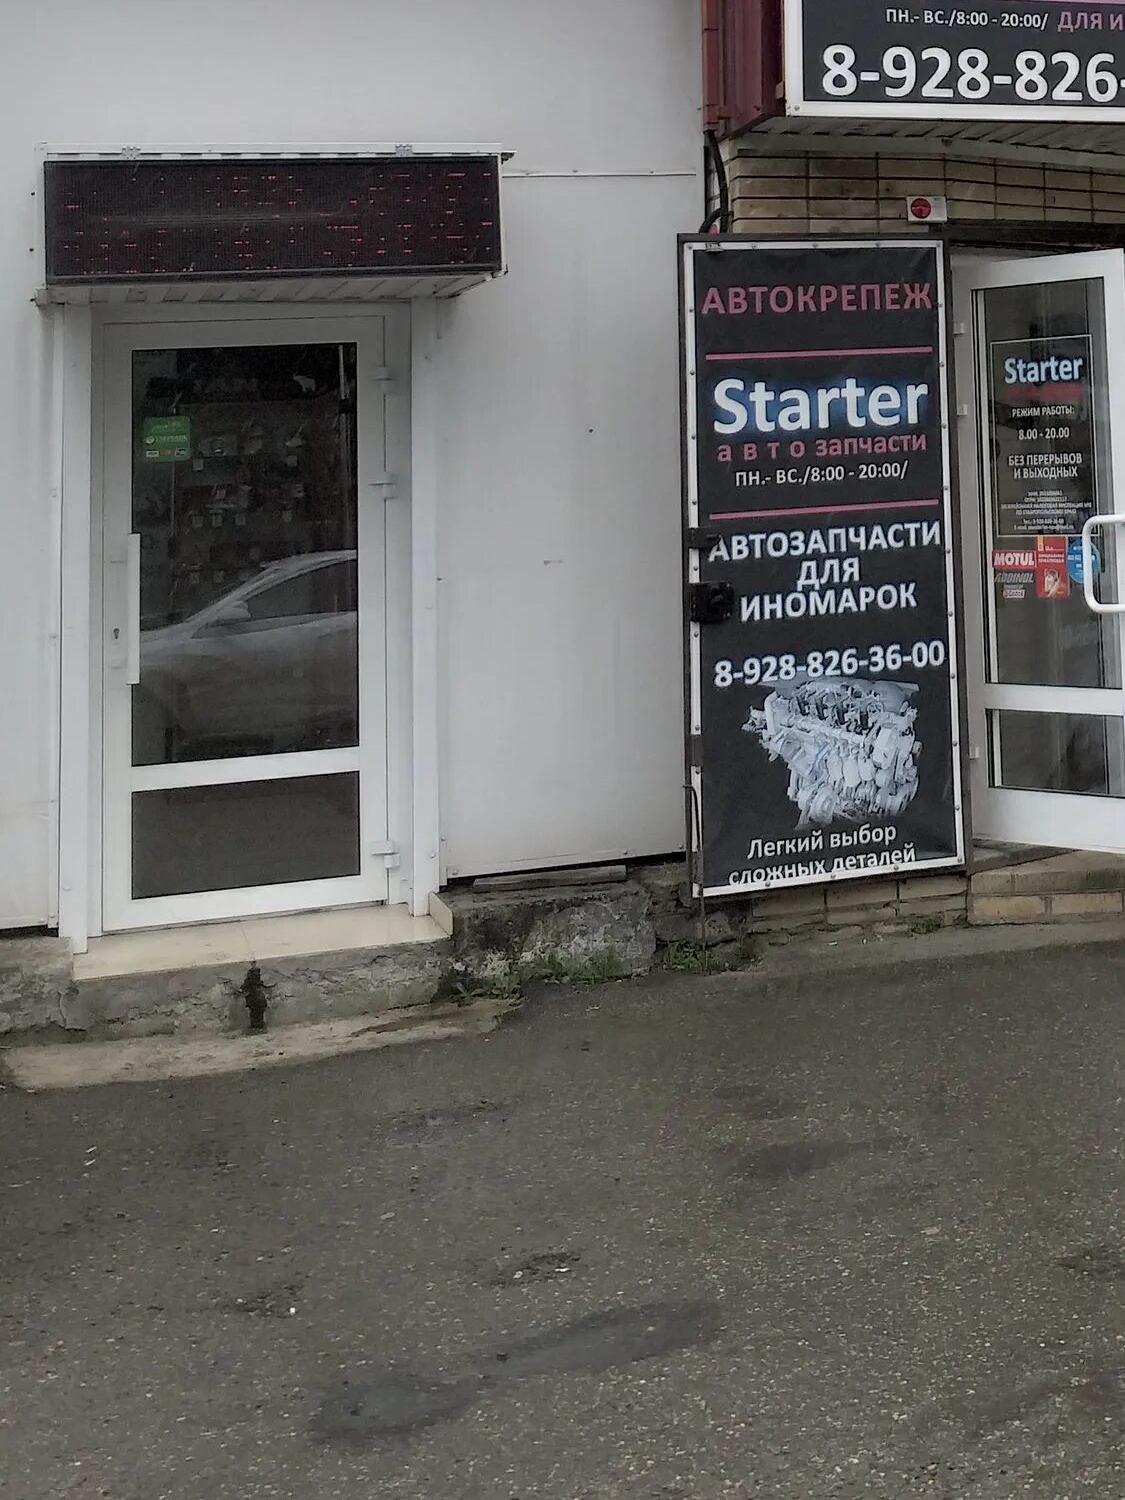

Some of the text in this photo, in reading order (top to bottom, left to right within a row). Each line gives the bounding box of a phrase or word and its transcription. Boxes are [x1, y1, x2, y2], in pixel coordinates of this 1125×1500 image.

[1057, 11, 1102, 32] ДЛЯ
[701, 282, 933, 316] АВТОКРЕПЕЖ
[1004, 356, 1084, 384] Starter
[713, 376, 929, 434] Starter
[1012, 406, 1040, 418] РЕЖИМ
[815, 434, 927, 457] запчасти
[1018, 428, 1038, 440] 8.00
[1045, 427, 1070, 439] 20.00
[1008, 453, 1083, 466] БЕЗ ПЕРЕРЫВОВ
[1013, 466, 1079, 480] И ВЫХОДНЫХ
[708, 520, 941, 562] АВТОЗАПЧАСТИ
[796, 556, 861, 591] ДЛЯ
[993, 552, 1035, 566] MOTUL
[740, 581, 918, 623] ИНОМАРОК
[714, 640, 946, 688] 8-928-826-36-00
[747, 823, 898, 860] Легкий выбор
[728, 842, 917, 886] сложных деталей
